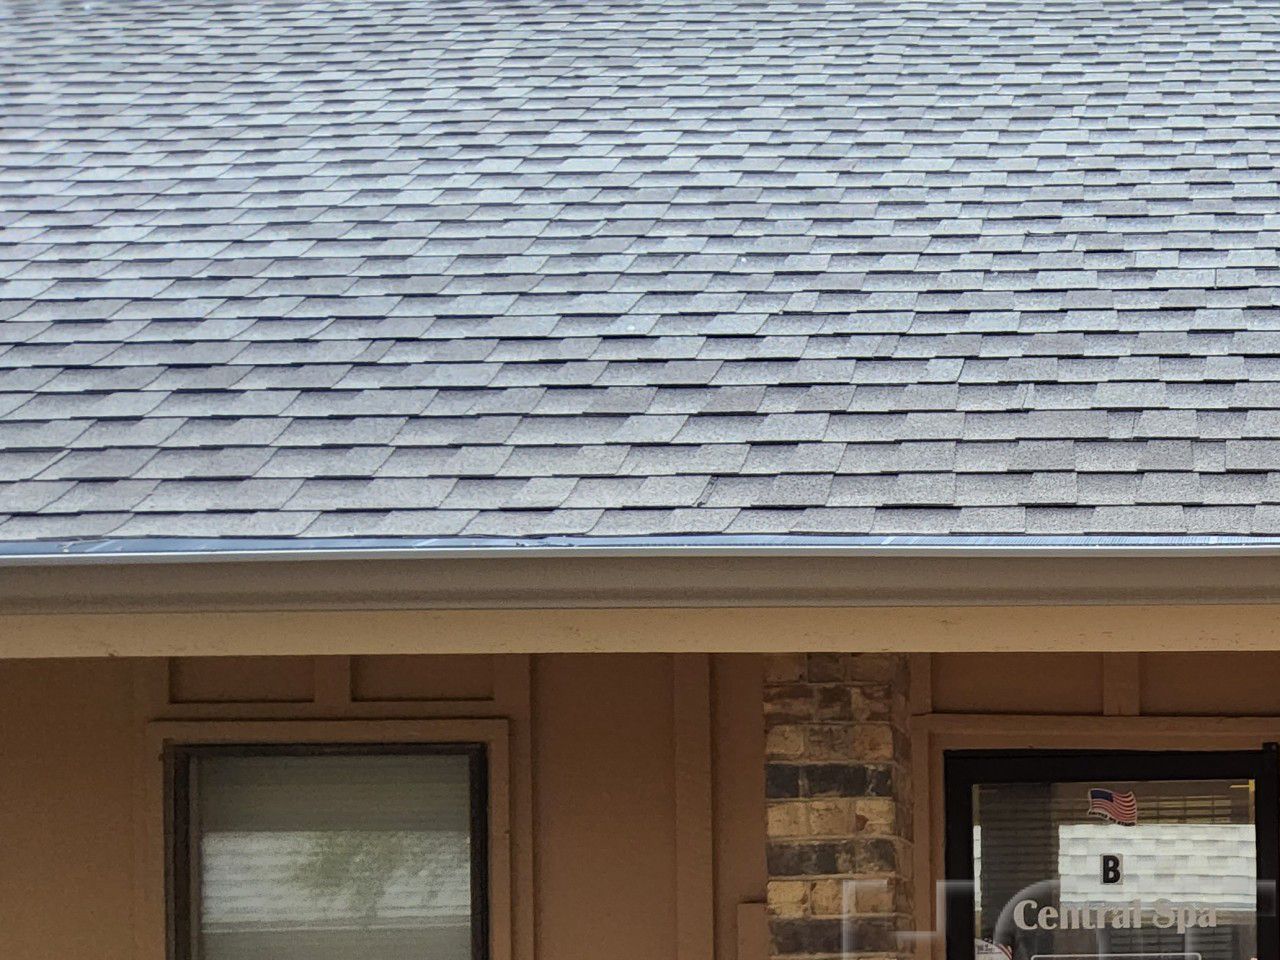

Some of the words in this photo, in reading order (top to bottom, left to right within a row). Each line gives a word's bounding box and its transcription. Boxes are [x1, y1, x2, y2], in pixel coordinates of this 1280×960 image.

[1102, 854, 1121, 884] B
[1012, 899, 1142, 930] Central
[1152, 898, 1217, 934] Spa
